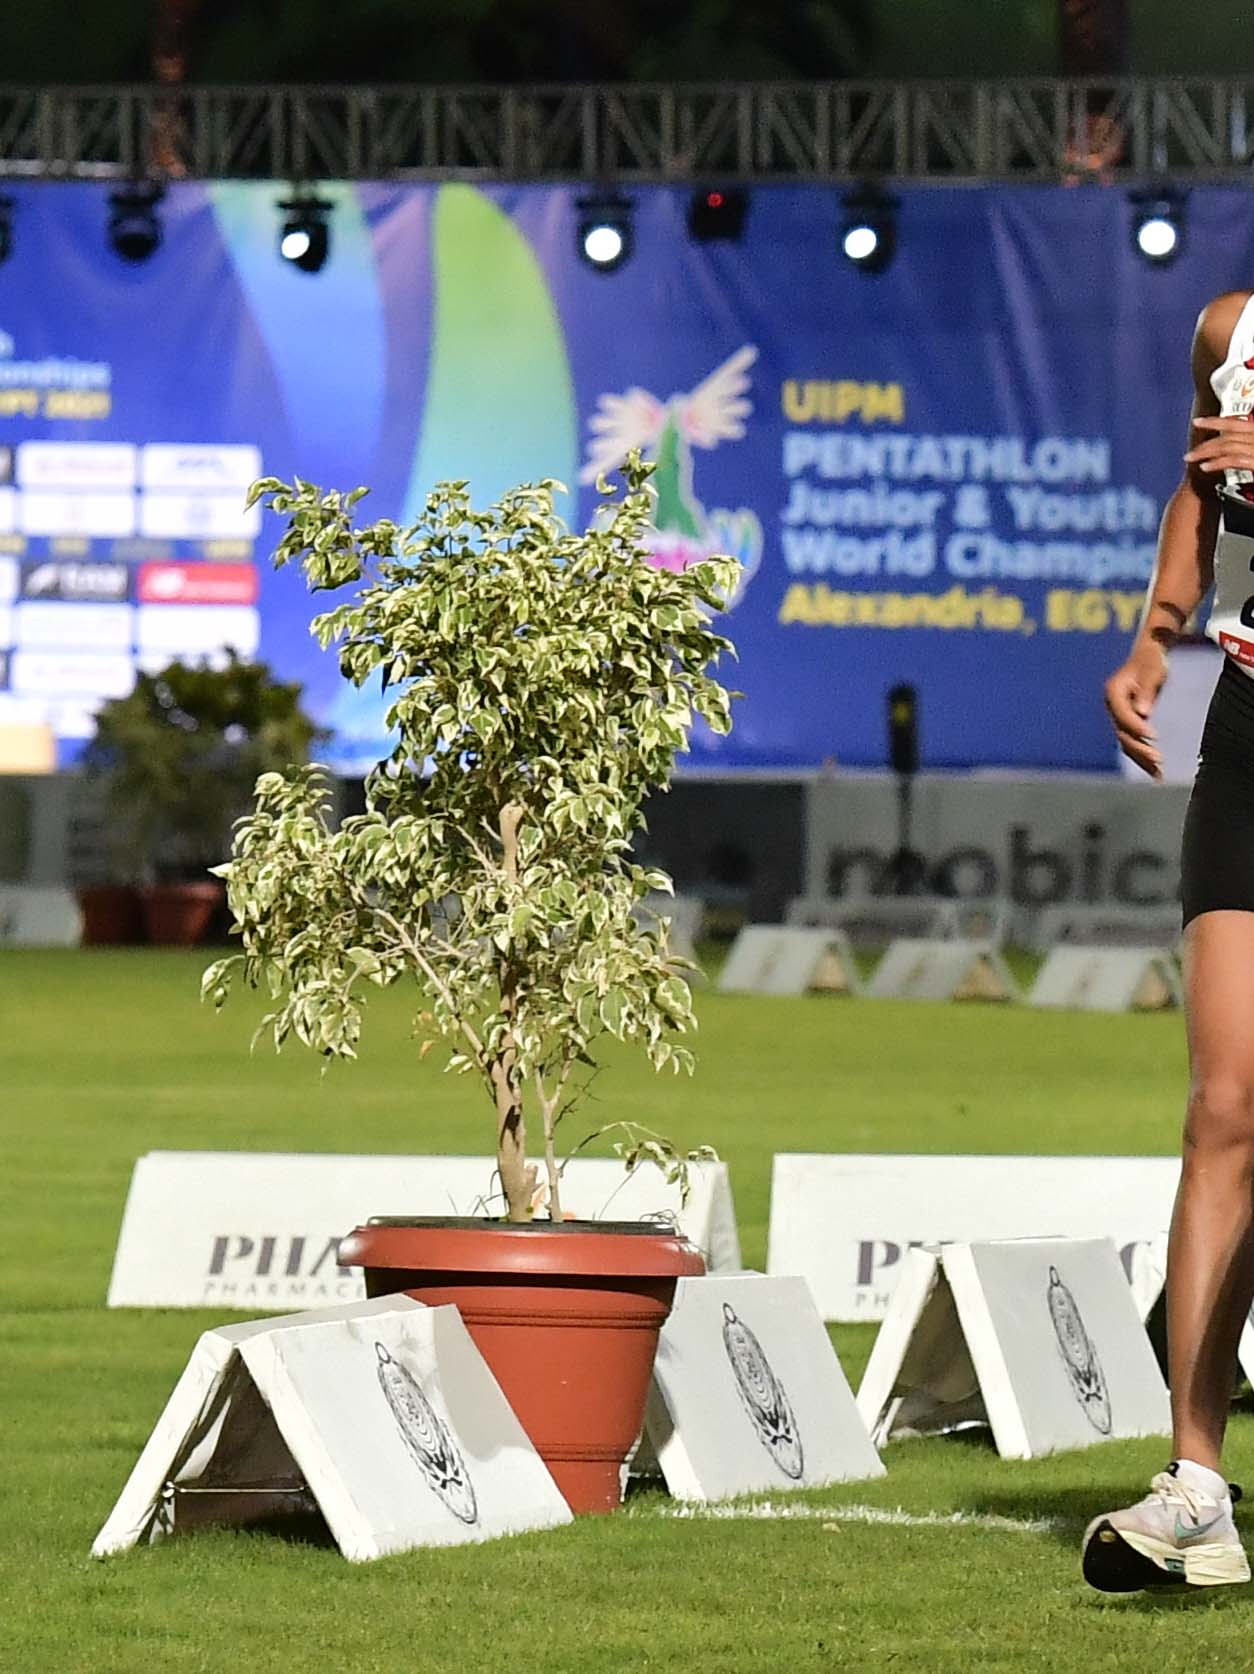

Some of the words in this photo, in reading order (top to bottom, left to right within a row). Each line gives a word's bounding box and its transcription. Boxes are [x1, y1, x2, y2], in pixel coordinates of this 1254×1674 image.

[782, 380, 905, 424] UIPM
[783, 432, 1111, 482] PENTATHLON
[783, 482, 944, 528] Junior
[954, 484, 991, 529] &
[1004, 483, 1157, 533] Youth
[782, 528, 937, 577] World
[779, 583, 1036, 637] Alexandria,
